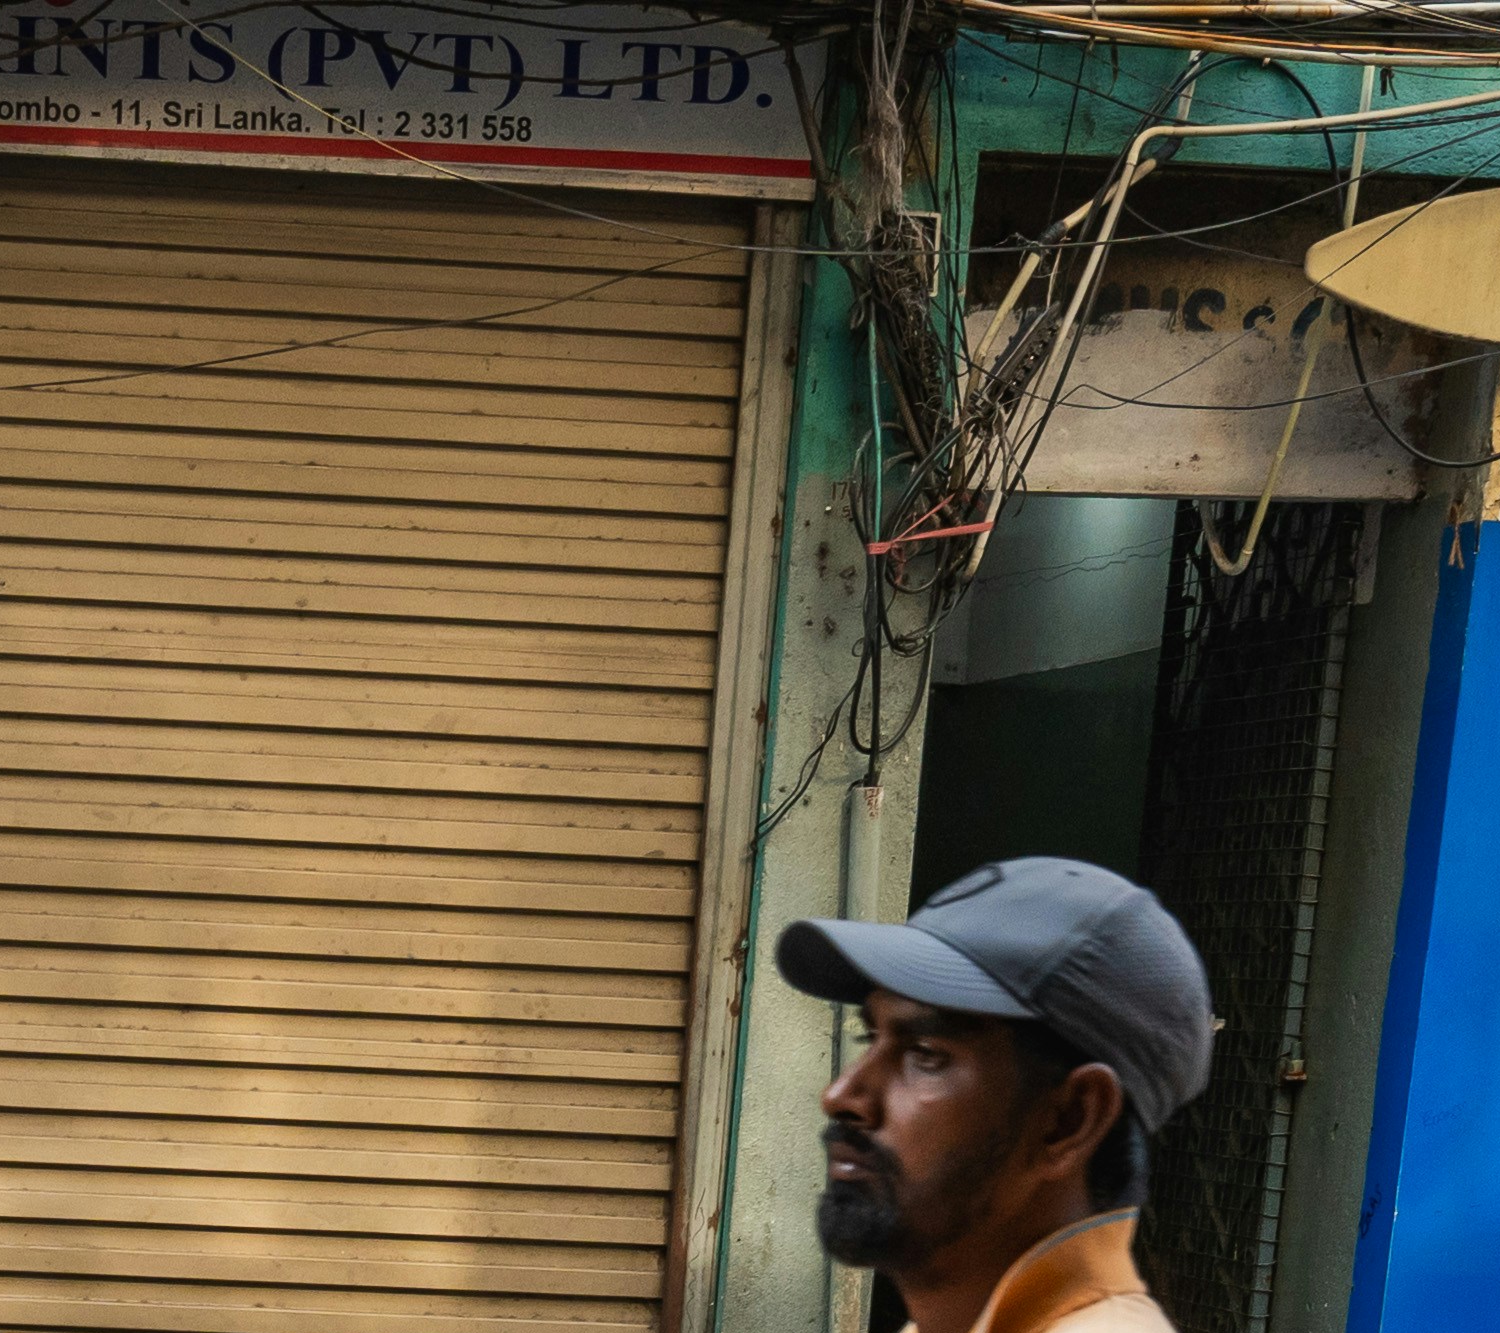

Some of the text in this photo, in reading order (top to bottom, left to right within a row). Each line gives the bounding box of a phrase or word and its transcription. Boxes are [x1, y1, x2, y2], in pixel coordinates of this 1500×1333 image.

[267, 26, 525, 111] (PVT)
[555, 38, 773, 108] LTD.
[111, 101, 152, 132] 11,
[163, 102, 204, 128] Sri
[214, 105, 311, 133] Lanka.
[322, 108, 366, 134] Tel
[421, 113, 469, 139] 331
[482, 115, 532, 142] 558
